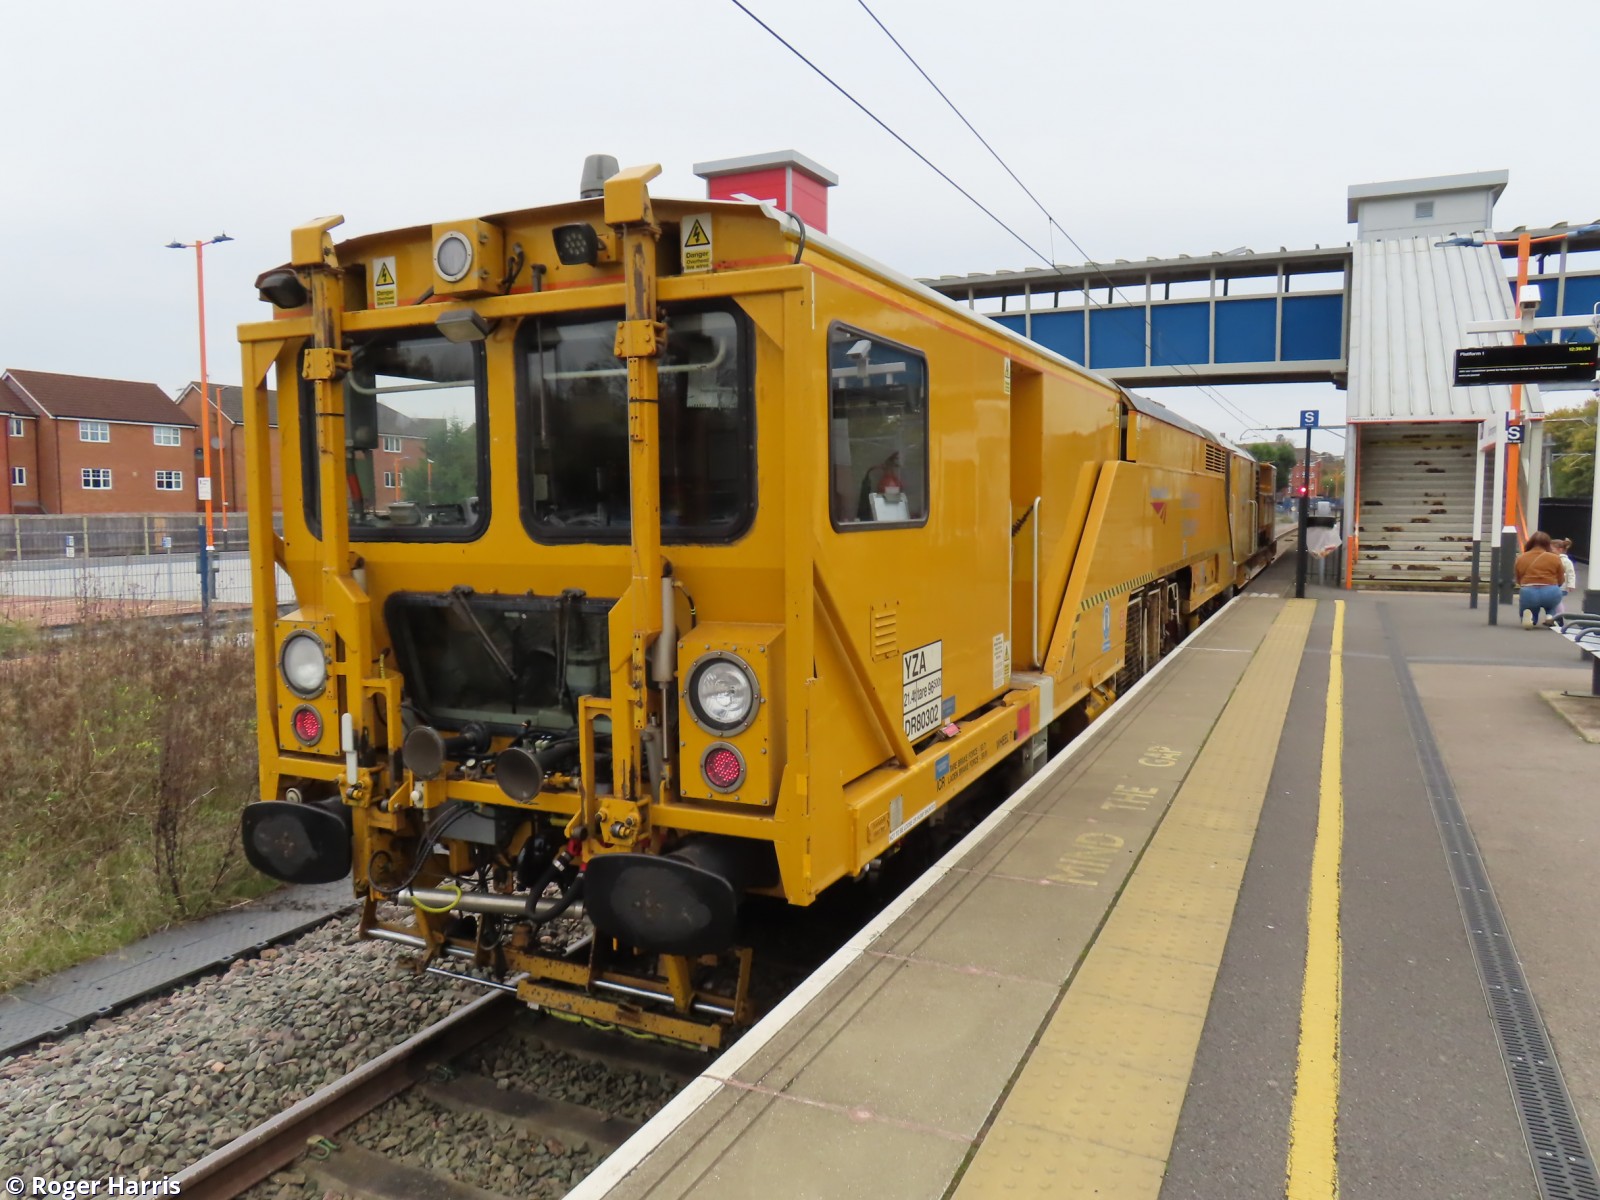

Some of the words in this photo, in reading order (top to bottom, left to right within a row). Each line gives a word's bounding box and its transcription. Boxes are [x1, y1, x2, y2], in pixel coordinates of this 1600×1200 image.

[686, 251, 709, 259] Danger
[1304, 411, 1315, 423] S
[1508, 426, 1521, 440] S
[904, 650, 927, 680] YZA
[905, 704, 939, 736] DR80302
[1046, 832, 1124, 886] MIND
[1100, 784, 1159, 812] THE
[1138, 745, 1183, 767] GAP
